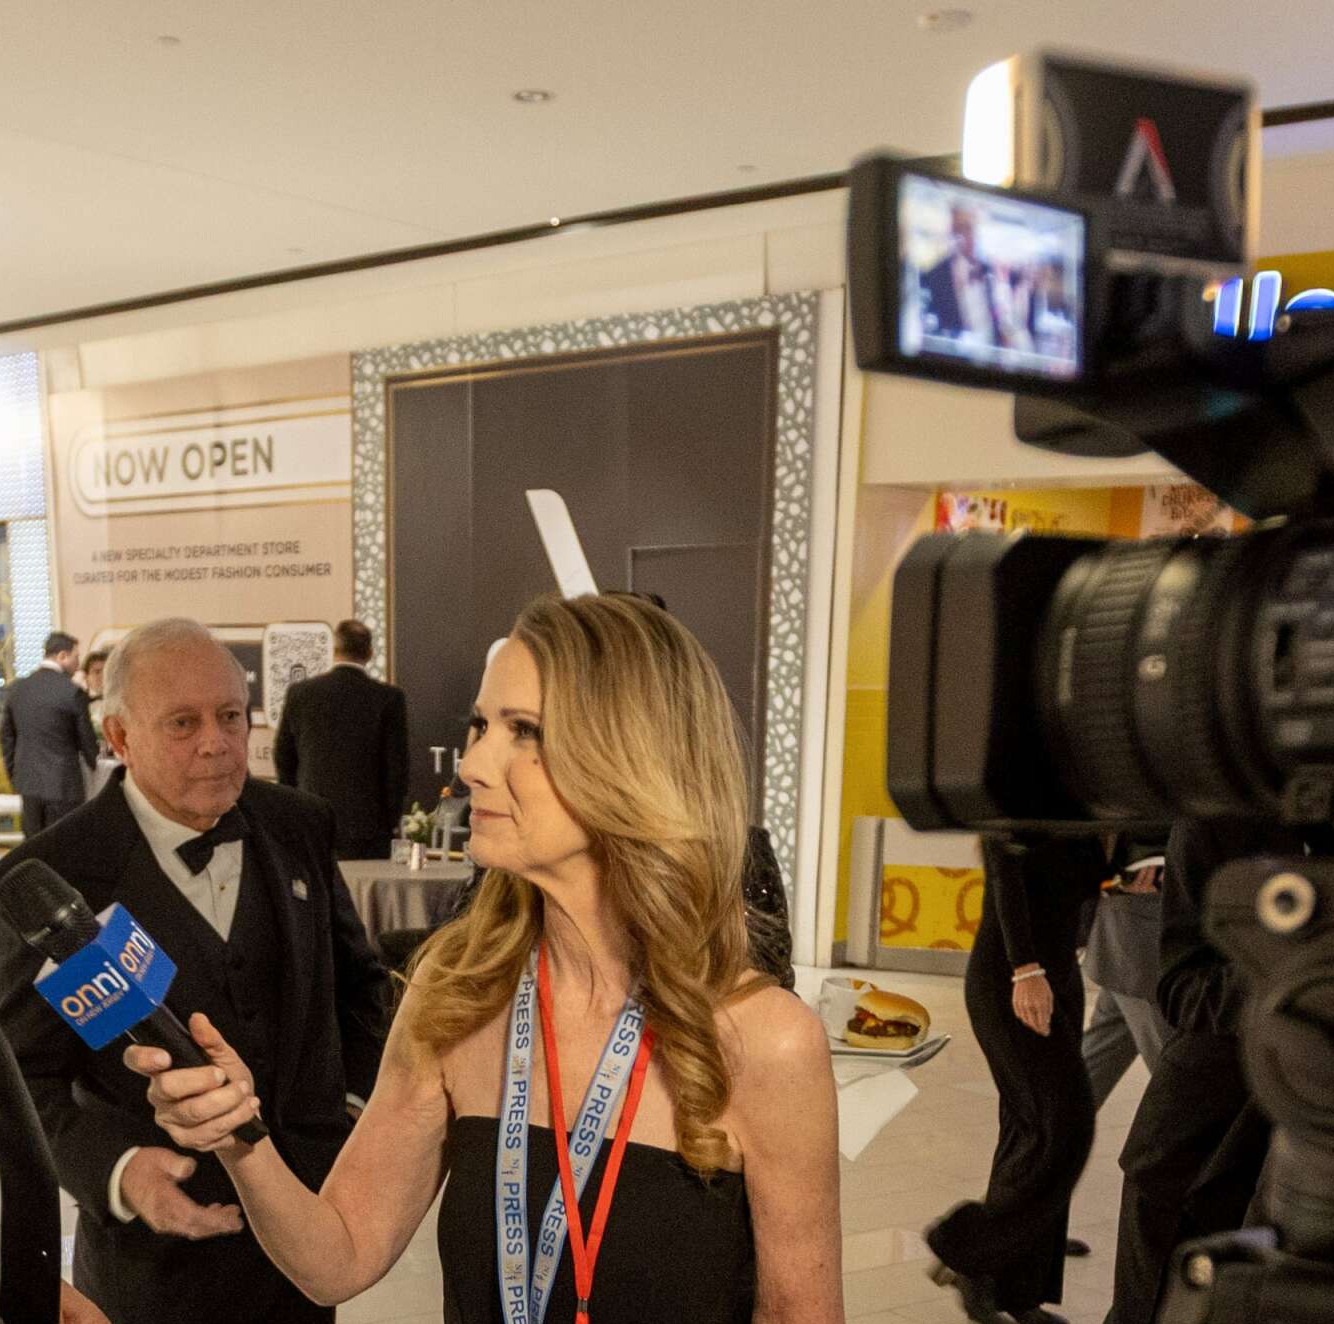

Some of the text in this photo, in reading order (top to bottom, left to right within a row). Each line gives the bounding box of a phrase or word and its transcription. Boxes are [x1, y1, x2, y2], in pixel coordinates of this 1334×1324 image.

[93, 434, 274, 486] NOW OPEN
[74, 561, 332, 585] CURATED FOR THE MODEST FASHION CONSUMER
[100, 549, 123, 561] NEW
[125, 546, 181, 561] SPECIALTY
[184, 543, 259, 559] DEPARTMENT
[261, 540, 300, 555] STORE
[119, 920, 156, 973] onnj
[61, 960, 130, 1018] onnj
[515, 978, 535, 1050] PRESS
[612, 1000, 647, 1058] RESS
[505, 1079, 527, 1150] PRESS
[574, 1083, 612, 1158] PRESS
[503, 1181, 524, 1256] PRESS
[541, 1199, 566, 1258] RESS
